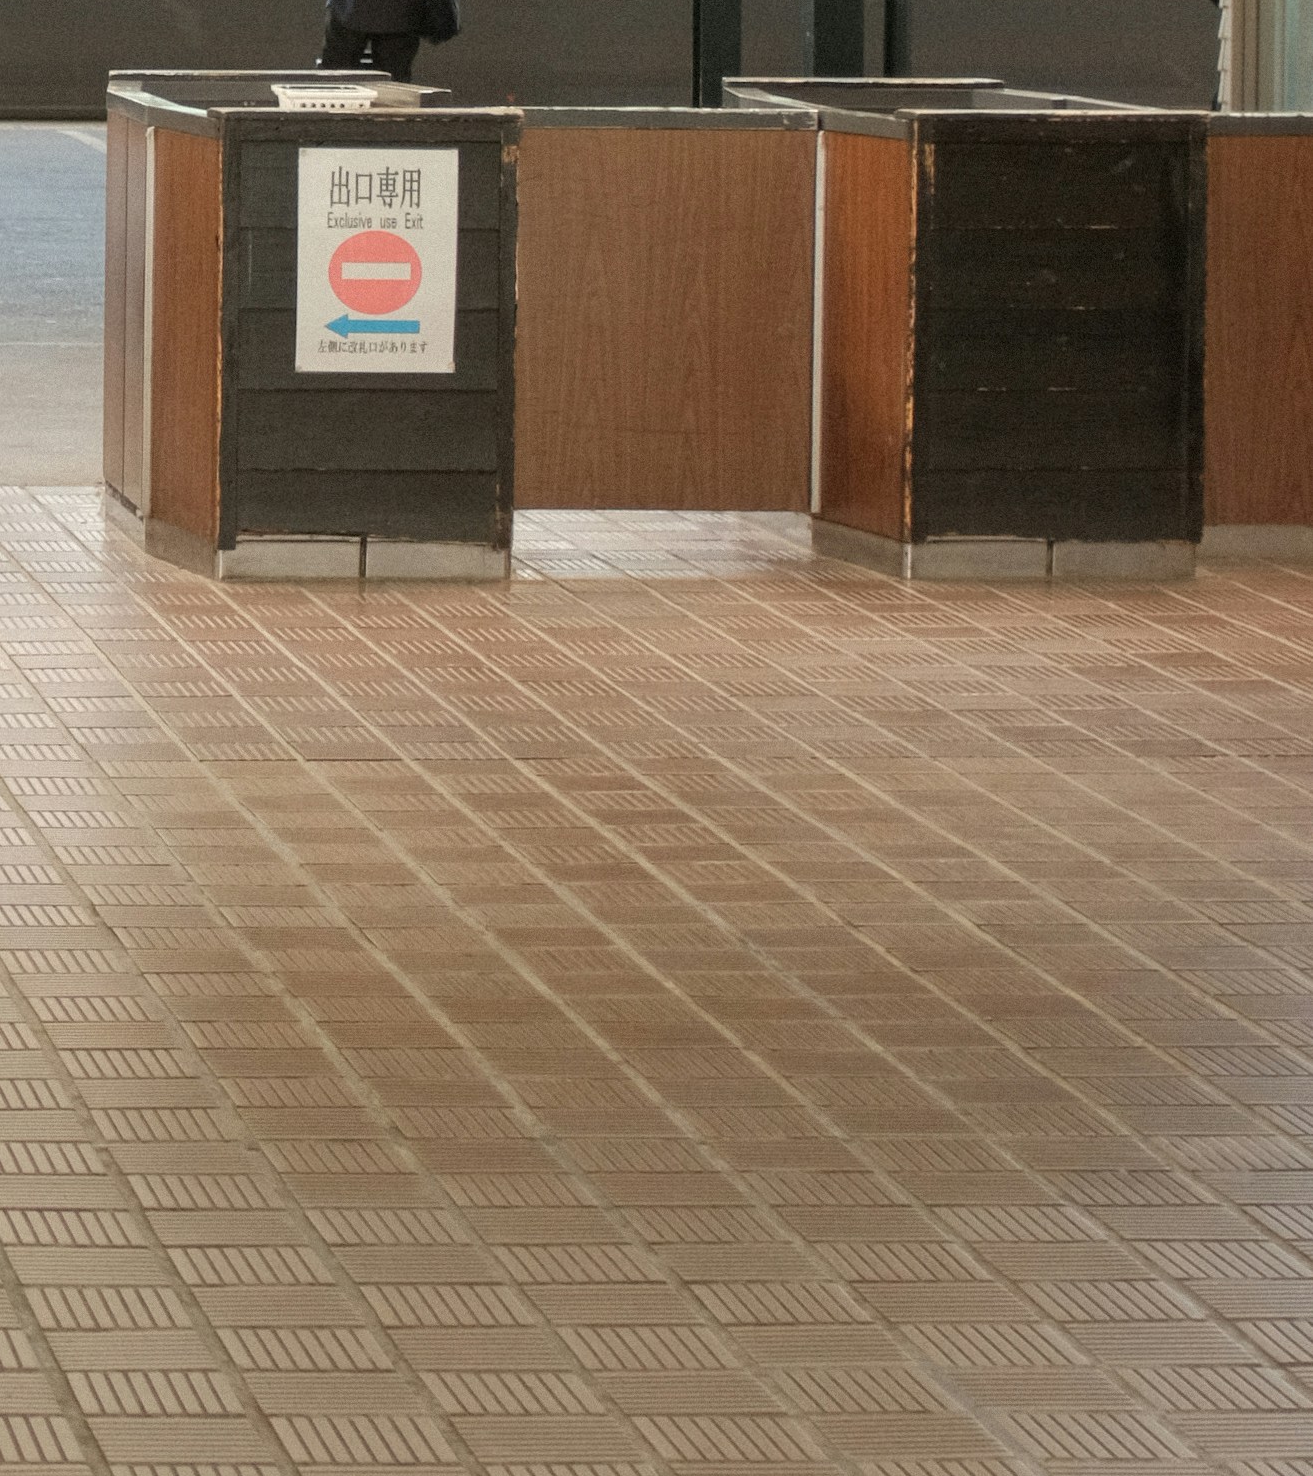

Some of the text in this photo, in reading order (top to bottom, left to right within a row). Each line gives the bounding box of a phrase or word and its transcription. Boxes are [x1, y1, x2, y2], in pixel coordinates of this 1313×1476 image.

[329, 165, 422, 209] 出口専用
[326, 211, 424, 230] Exclusive use Exit
[317, 339, 428, 354] 左側に改札口があります
